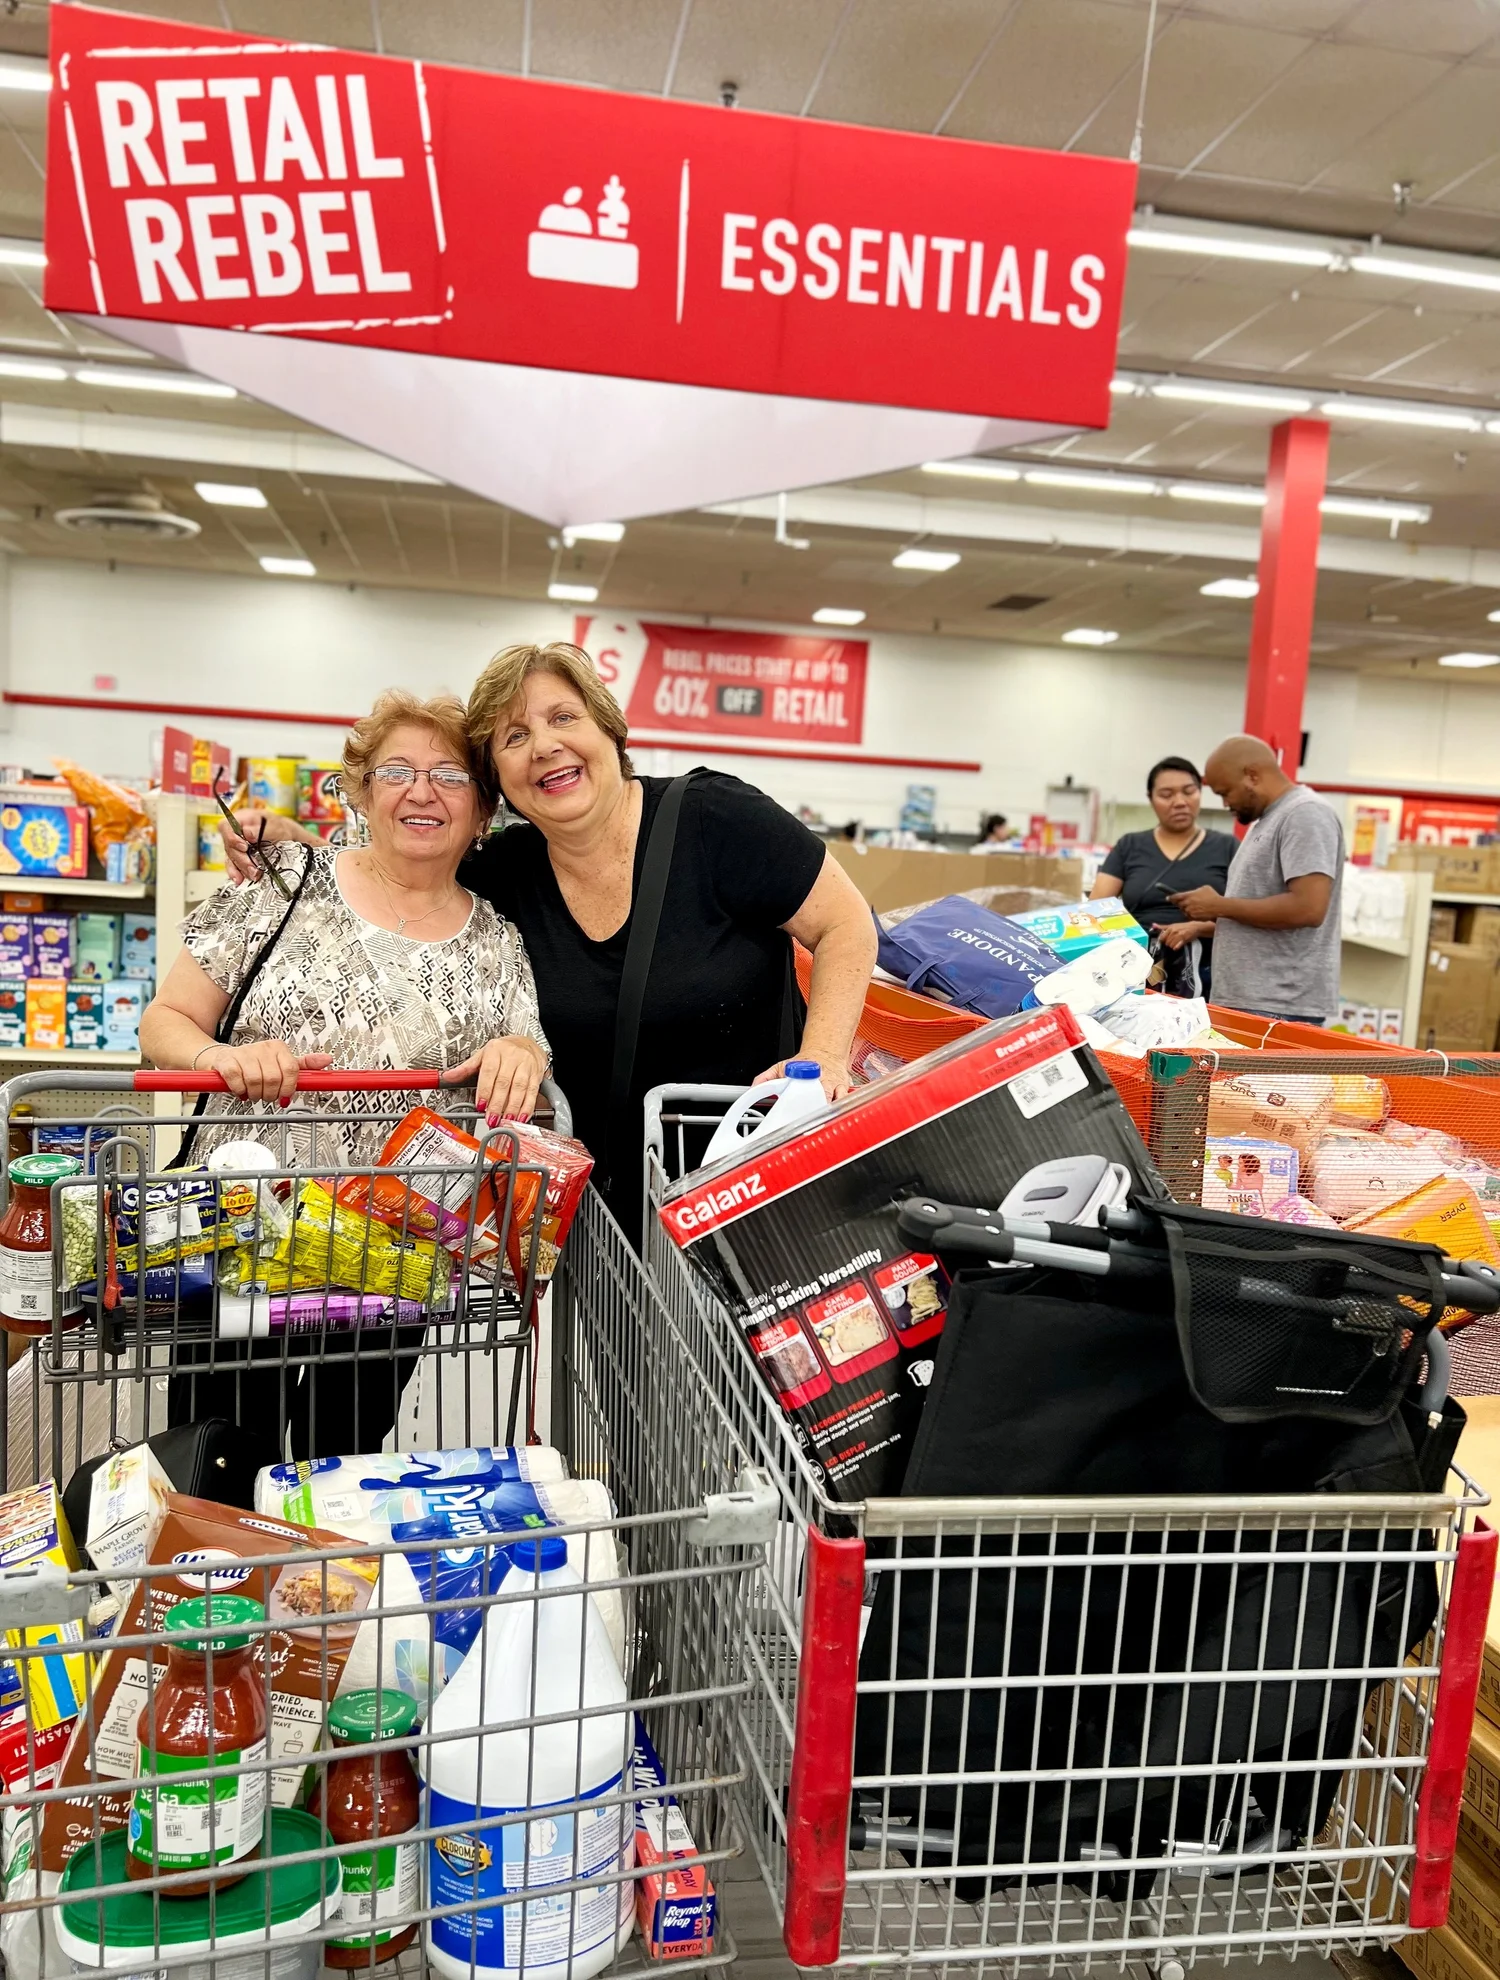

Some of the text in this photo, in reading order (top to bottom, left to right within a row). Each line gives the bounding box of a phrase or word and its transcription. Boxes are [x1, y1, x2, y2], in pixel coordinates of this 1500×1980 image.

[96, 74, 404, 188] RETAIL
[125, 190, 412, 304] REBEL
[721, 212, 1106, 330] ESSENTIALS
[706, 652, 751, 676] PRICES
[794, 660, 810, 680] AT
[811, 661, 829, 681] UP
[654, 675, 848, 726] 60% OFF RETAIL
[947, 928, 1045, 983] PANDORE
[995, 1022, 1058, 1059] Bread Maker
[1223, 1079, 1256, 1099] Pants
[676, 1173, 767, 1230] Galanz
[528, 1213, 553, 1226] PAF
[1440, 1202, 1467, 1222] DYPER
[891, 1258, 915, 1272] PASTA
[893, 1263, 919, 1281] DOUGH
[771, 1280, 791, 1296] Fast
[778, 1282, 821, 1310] Baking
[819, 1248, 882, 1288] Versatility
[825, 1294, 846, 1308] CAKE
[831, 1428, 849, 1441] dough
[859, 1414, 874, 1425] more
[824, 1441, 867, 1467] LCD DISPLAY
[846, 1452, 865, 1465] choose
[94, 1522, 149, 1556] MAPLE GROVE
[113, 1543, 144, 1561] BELGIAN
[150, 1589, 179, 1601] WE'RE
[198, 1640, 226, 1650] MLD
[330, 1724, 348, 1737] MILD
[14, 1724, 71, 1758] BASMTI
[97, 1746, 135, 1759] HOW MUC
[343, 1864, 372, 1876] hunky
[664, 1917, 690, 1932] Wrap
[662, 1942, 706, 1954] EVERYDA
